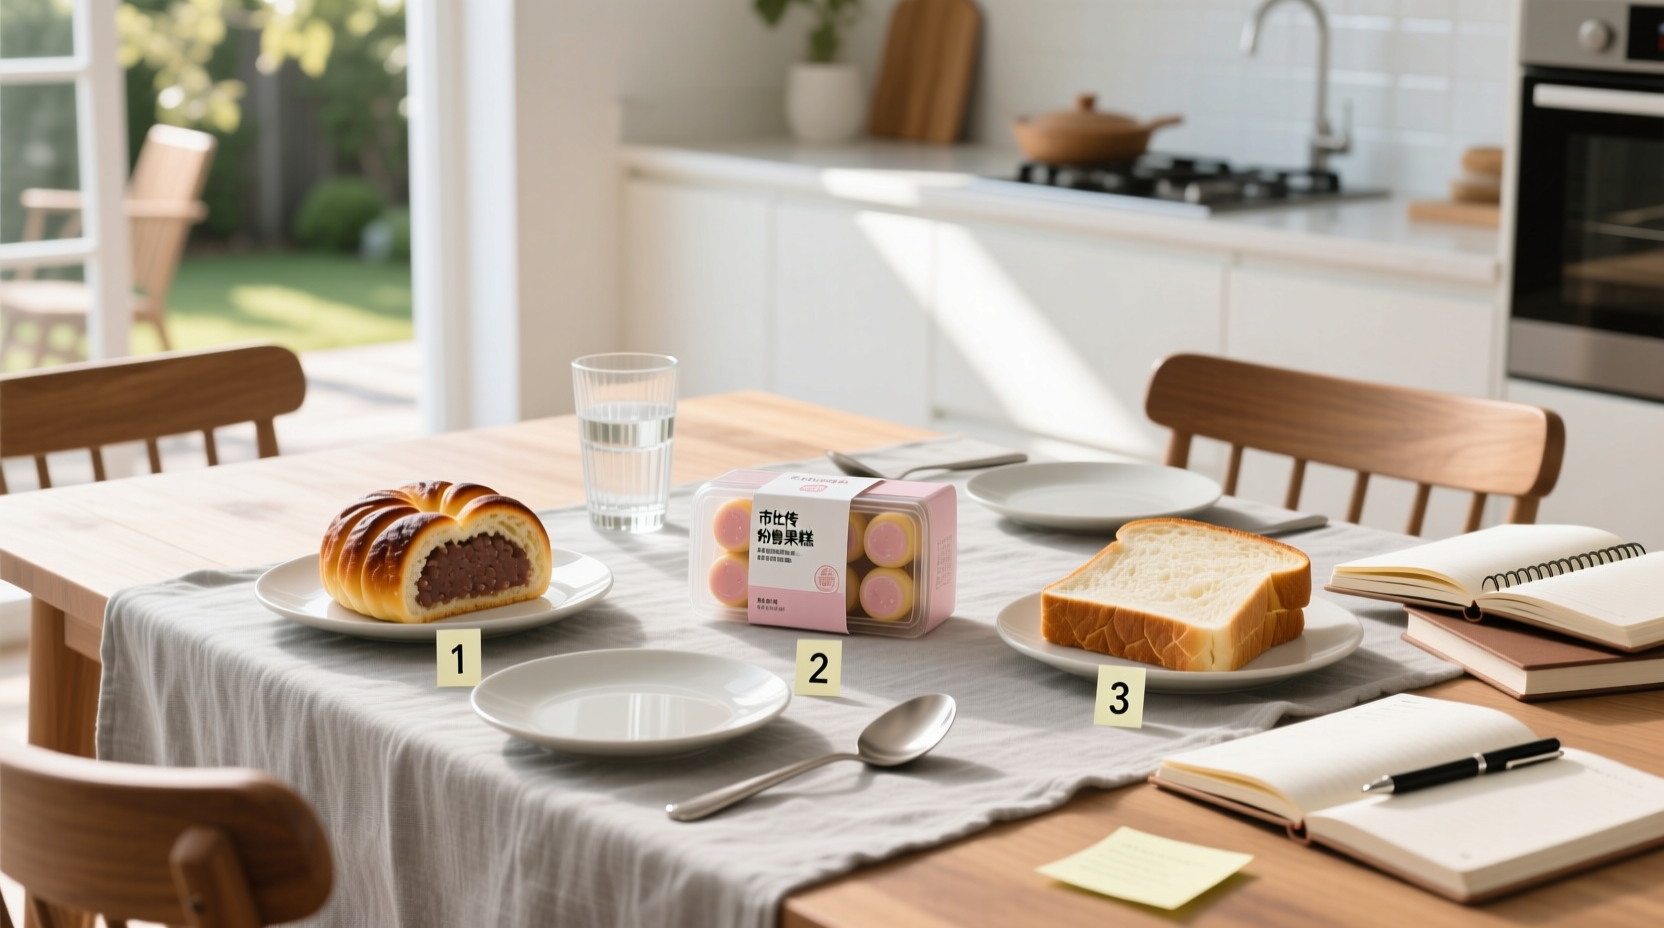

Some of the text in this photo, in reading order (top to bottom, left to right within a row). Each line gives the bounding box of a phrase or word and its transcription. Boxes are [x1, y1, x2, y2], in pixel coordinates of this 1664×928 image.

[451, 643, 464, 675] 1
[808, 652, 829, 684] 2
[1109, 681, 1129, 715] 3
